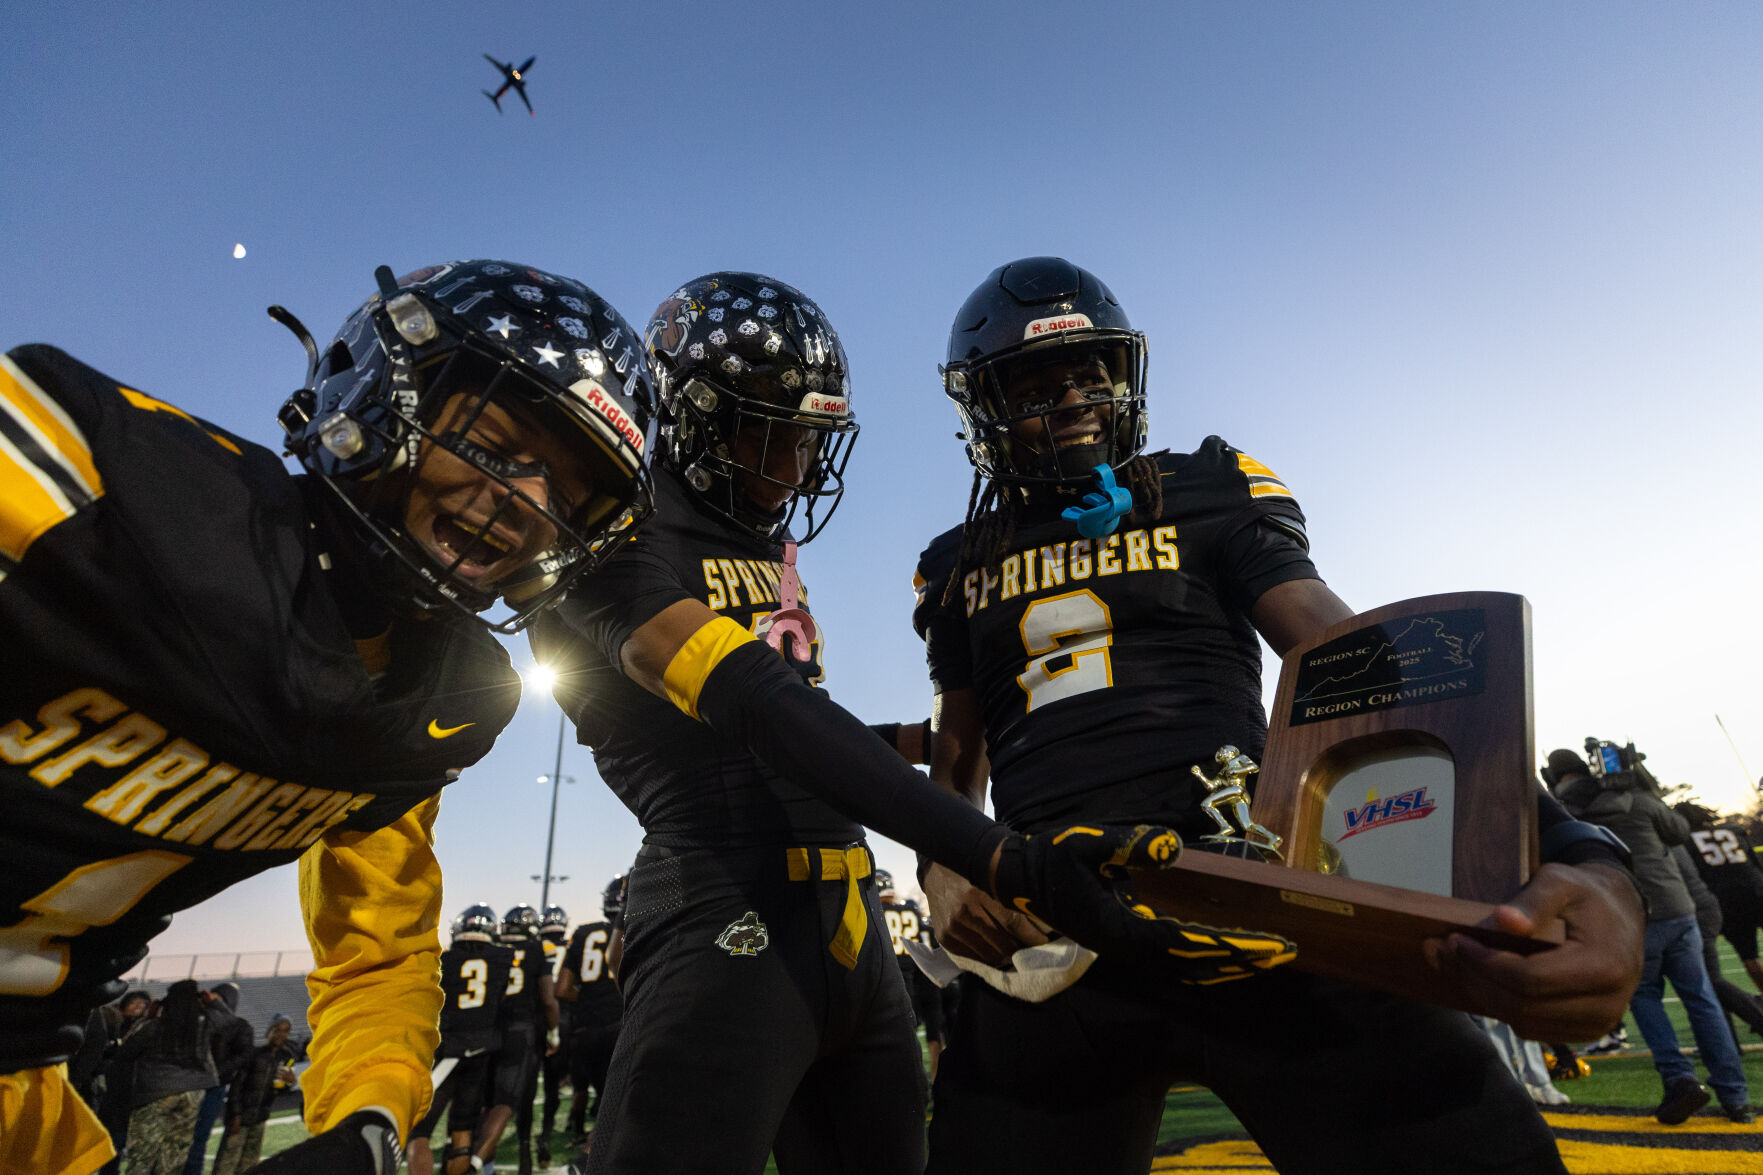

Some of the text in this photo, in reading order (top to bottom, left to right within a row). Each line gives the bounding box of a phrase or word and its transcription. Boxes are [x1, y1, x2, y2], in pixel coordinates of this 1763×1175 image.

[1031, 317, 1086, 335] Rddell
[587, 387, 643, 451] Riddell
[811, 397, 847, 413] Rddell
[963, 525, 1179, 618] SPRINGERS
[1016, 588, 1113, 714] 2
[1308, 650, 1352, 668] REGION
[1399, 657, 1421, 667] 2025
[1304, 679, 1468, 718] REGION CHAMPIONS
[0, 688, 376, 852] SPRINGERS
[1345, 787, 1434, 830] VHSL
[1690, 829, 1747, 866] 52
[884, 910, 919, 955] 82
[580, 930, 614, 982] 6
[458, 958, 488, 1009] 3
